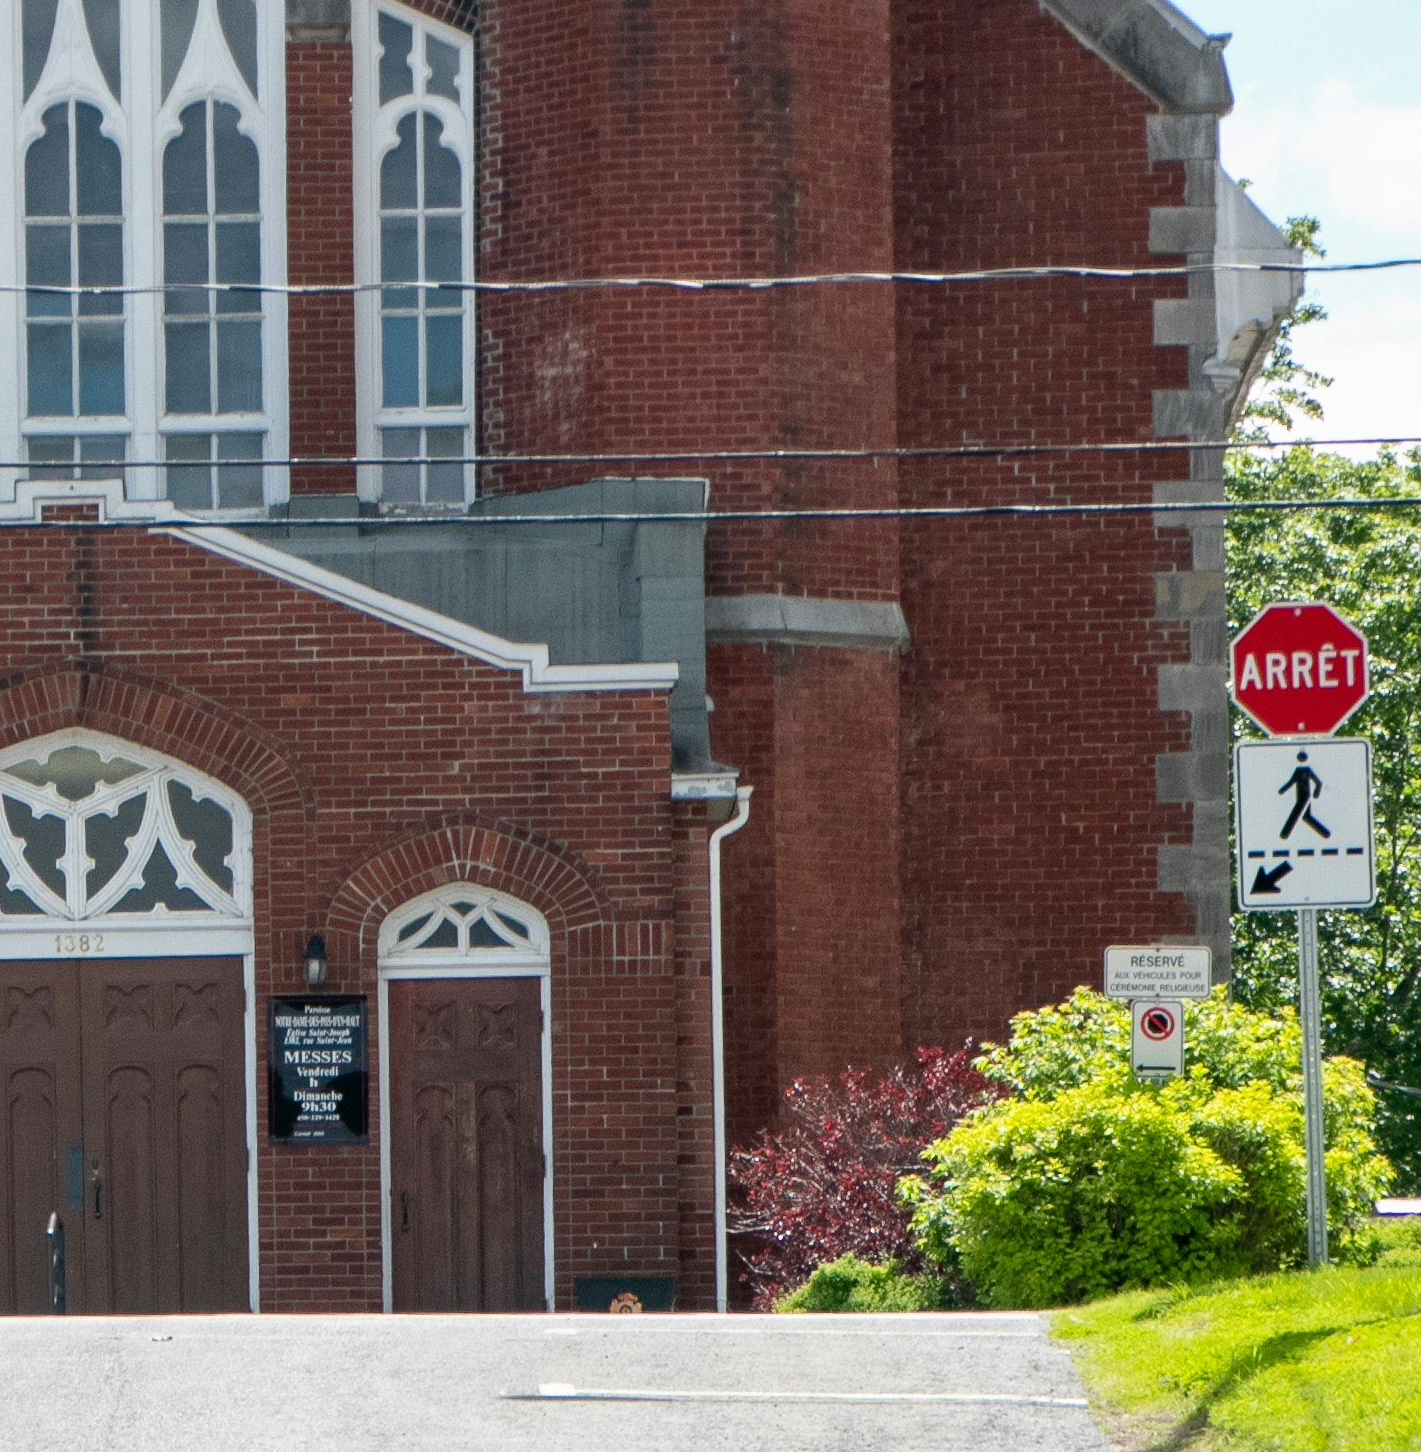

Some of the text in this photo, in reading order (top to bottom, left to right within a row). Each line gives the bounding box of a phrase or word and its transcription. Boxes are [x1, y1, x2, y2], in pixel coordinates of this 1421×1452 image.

[1240, 642, 1359, 690] ARRÊT
[54, 934, 105, 953] 1382
[1130, 954, 1185, 968] RÉSERVÉ
[1114, 970, 1202, 980] AUX VÉHICULES POUR
[1109, 982, 1206, 992] CÉRÉMONIE RELIGIEUSE
[284, 1050, 352, 1064] MESSES
[297, 1066, 339, 1077] Vendredi
[309, 1077, 319, 1088] h
[293, 1091, 343, 1101] Dimanche
[301, 1102, 337, 1112] 9h30
